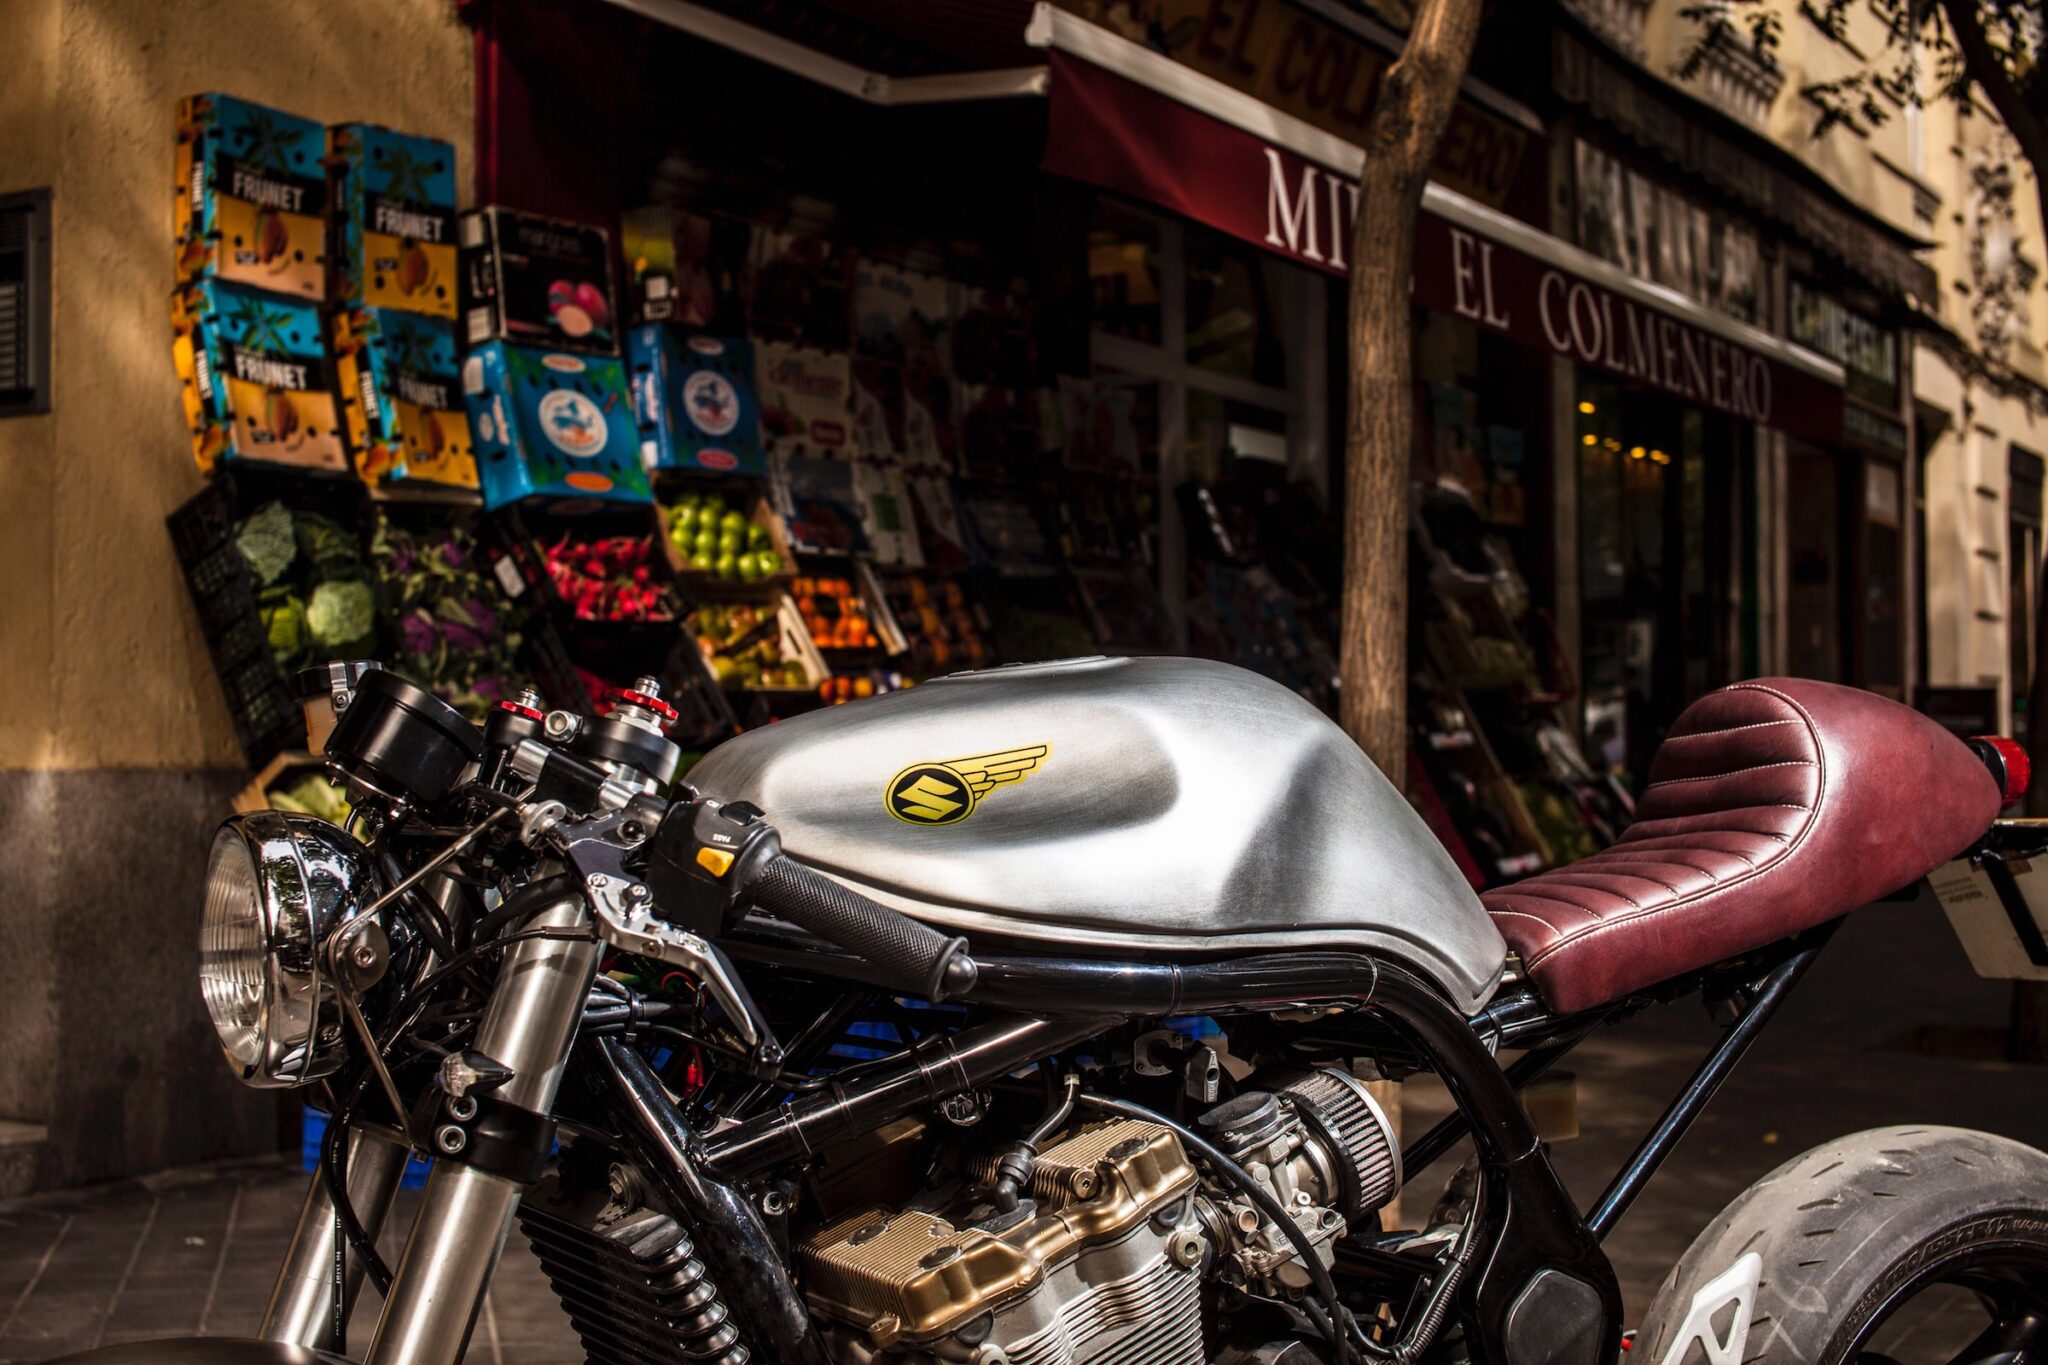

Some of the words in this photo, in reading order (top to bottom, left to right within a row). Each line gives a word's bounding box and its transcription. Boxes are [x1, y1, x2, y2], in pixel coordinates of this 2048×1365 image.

[233, 171, 306, 212] FRUNET
[375, 205, 445, 243] FRUNET
[1449, 226, 1511, 331] EL
[1537, 269, 1773, 424] COLMENERO
[235, 353, 308, 391] FRUNET
